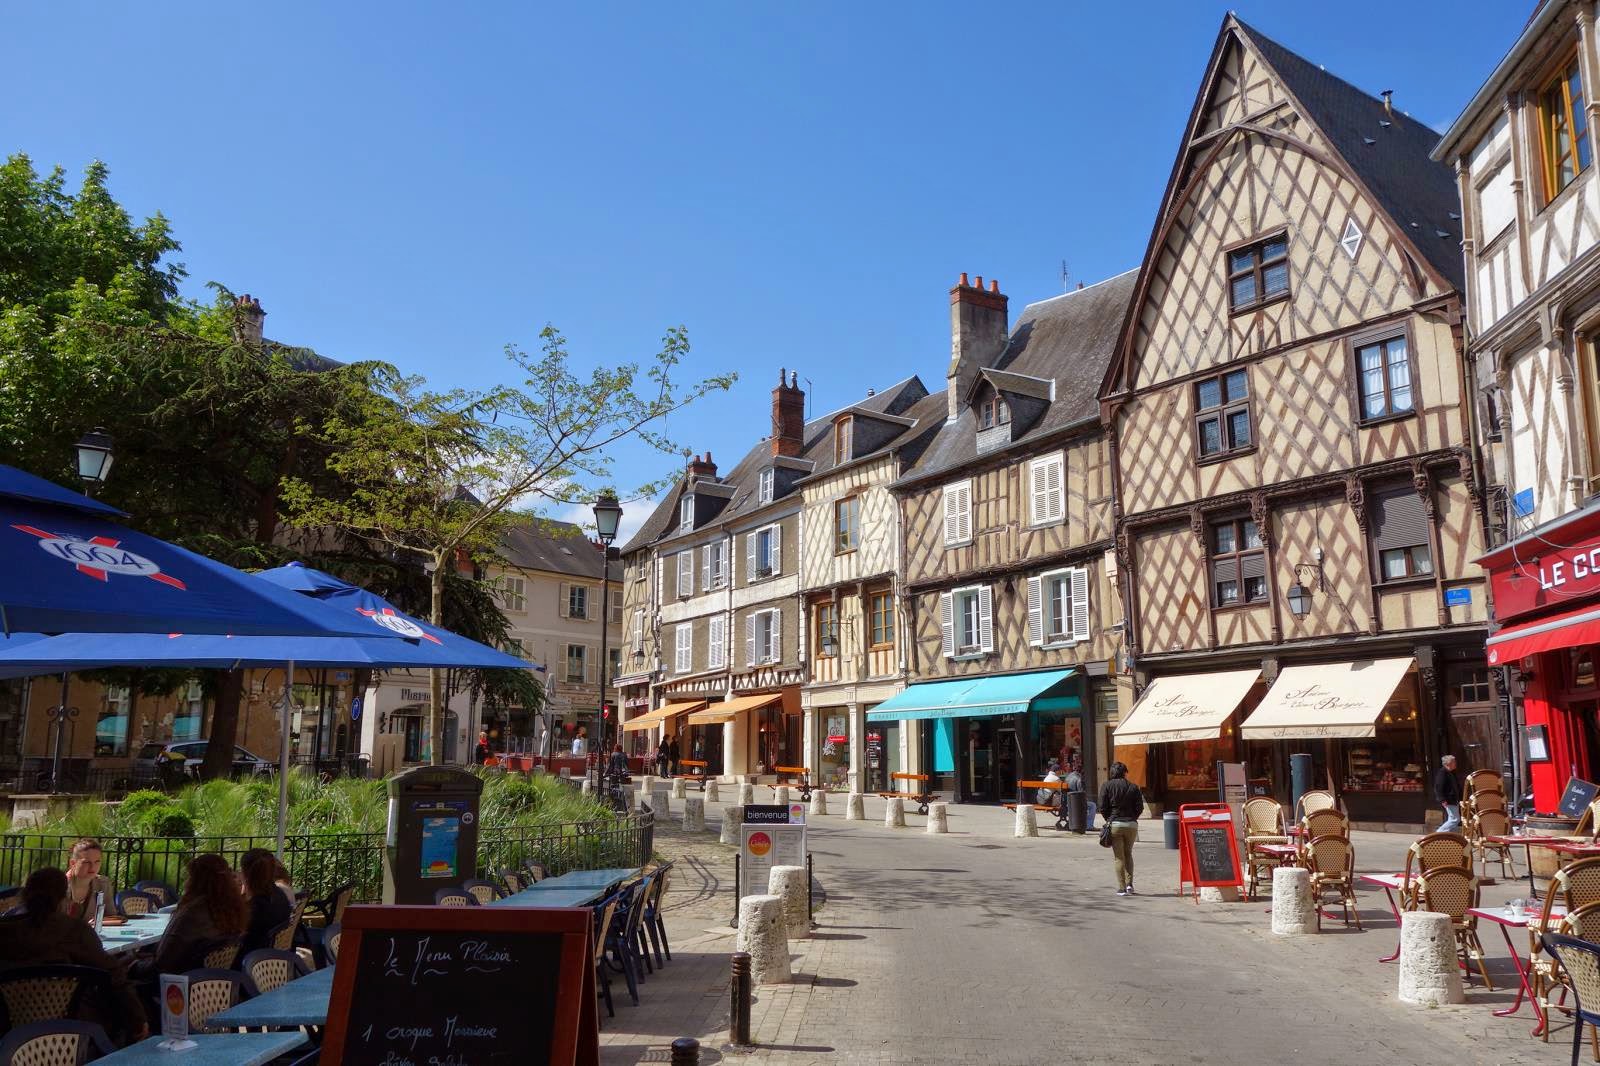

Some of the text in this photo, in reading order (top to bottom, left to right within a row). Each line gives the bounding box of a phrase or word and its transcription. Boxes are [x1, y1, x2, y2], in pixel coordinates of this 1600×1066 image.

[50, 542, 149, 570] 1664
[1540, 561, 1566, 590] LE
[747, 809, 788, 820] bienvenue
[411, 936, 452, 985] Menu
[361, 1023, 372, 1043] 1
